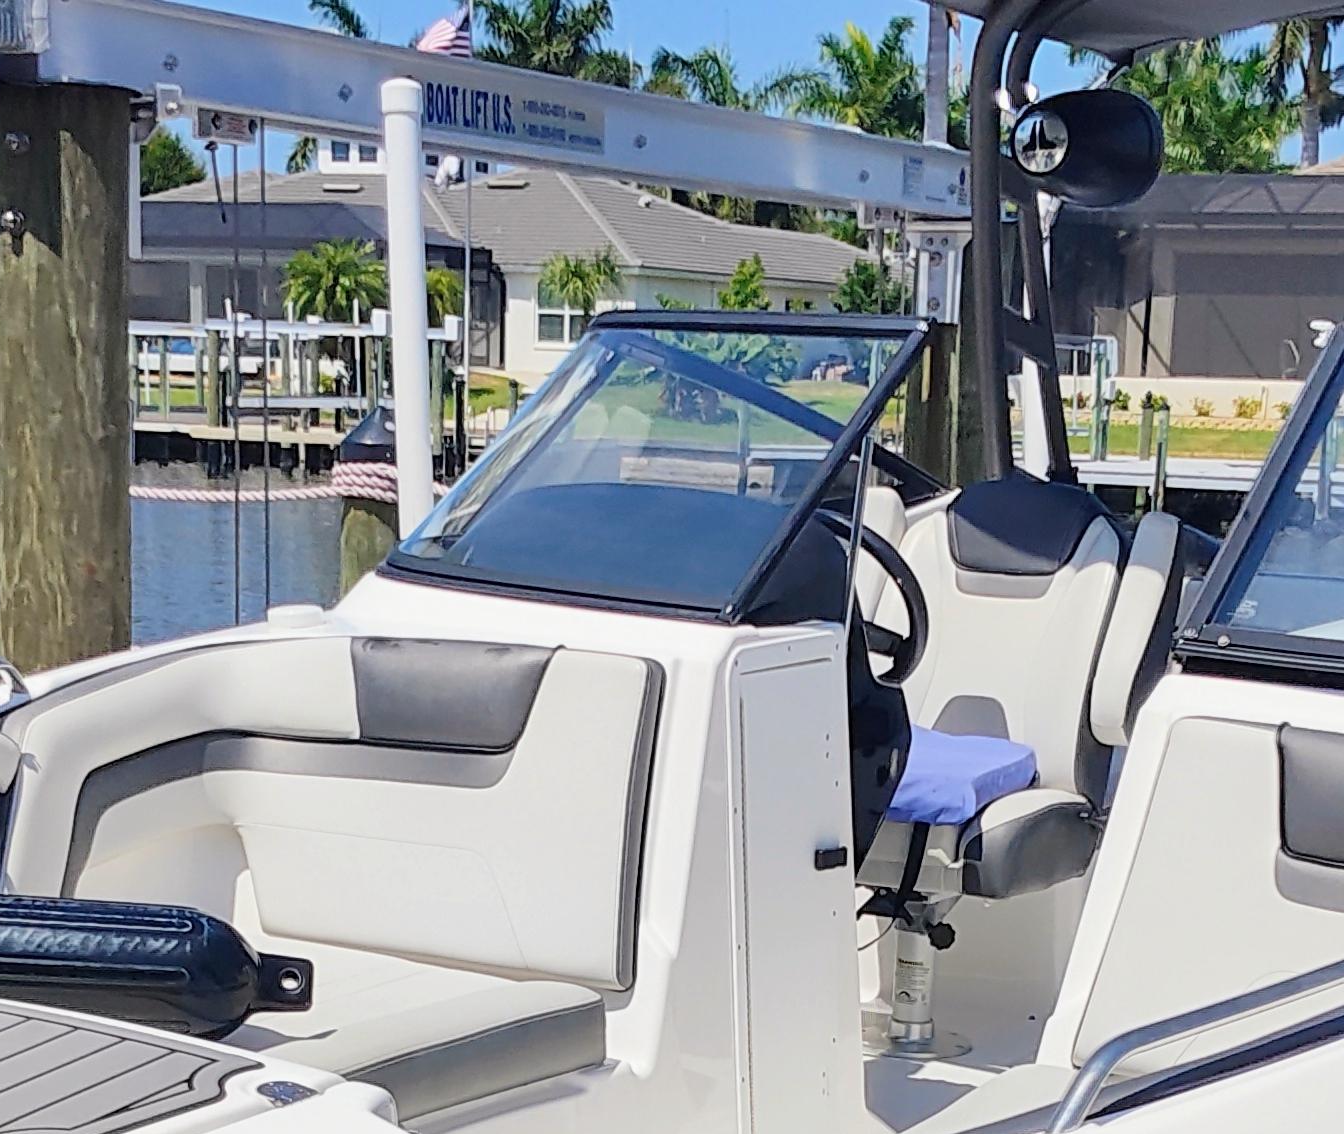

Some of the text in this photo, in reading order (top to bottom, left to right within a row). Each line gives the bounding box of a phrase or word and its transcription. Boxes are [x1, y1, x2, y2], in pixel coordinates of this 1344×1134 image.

[426, 82, 458, 126] BOAT
[462, 88, 489, 130] LIFT
[492, 93, 517, 135] U.S.
